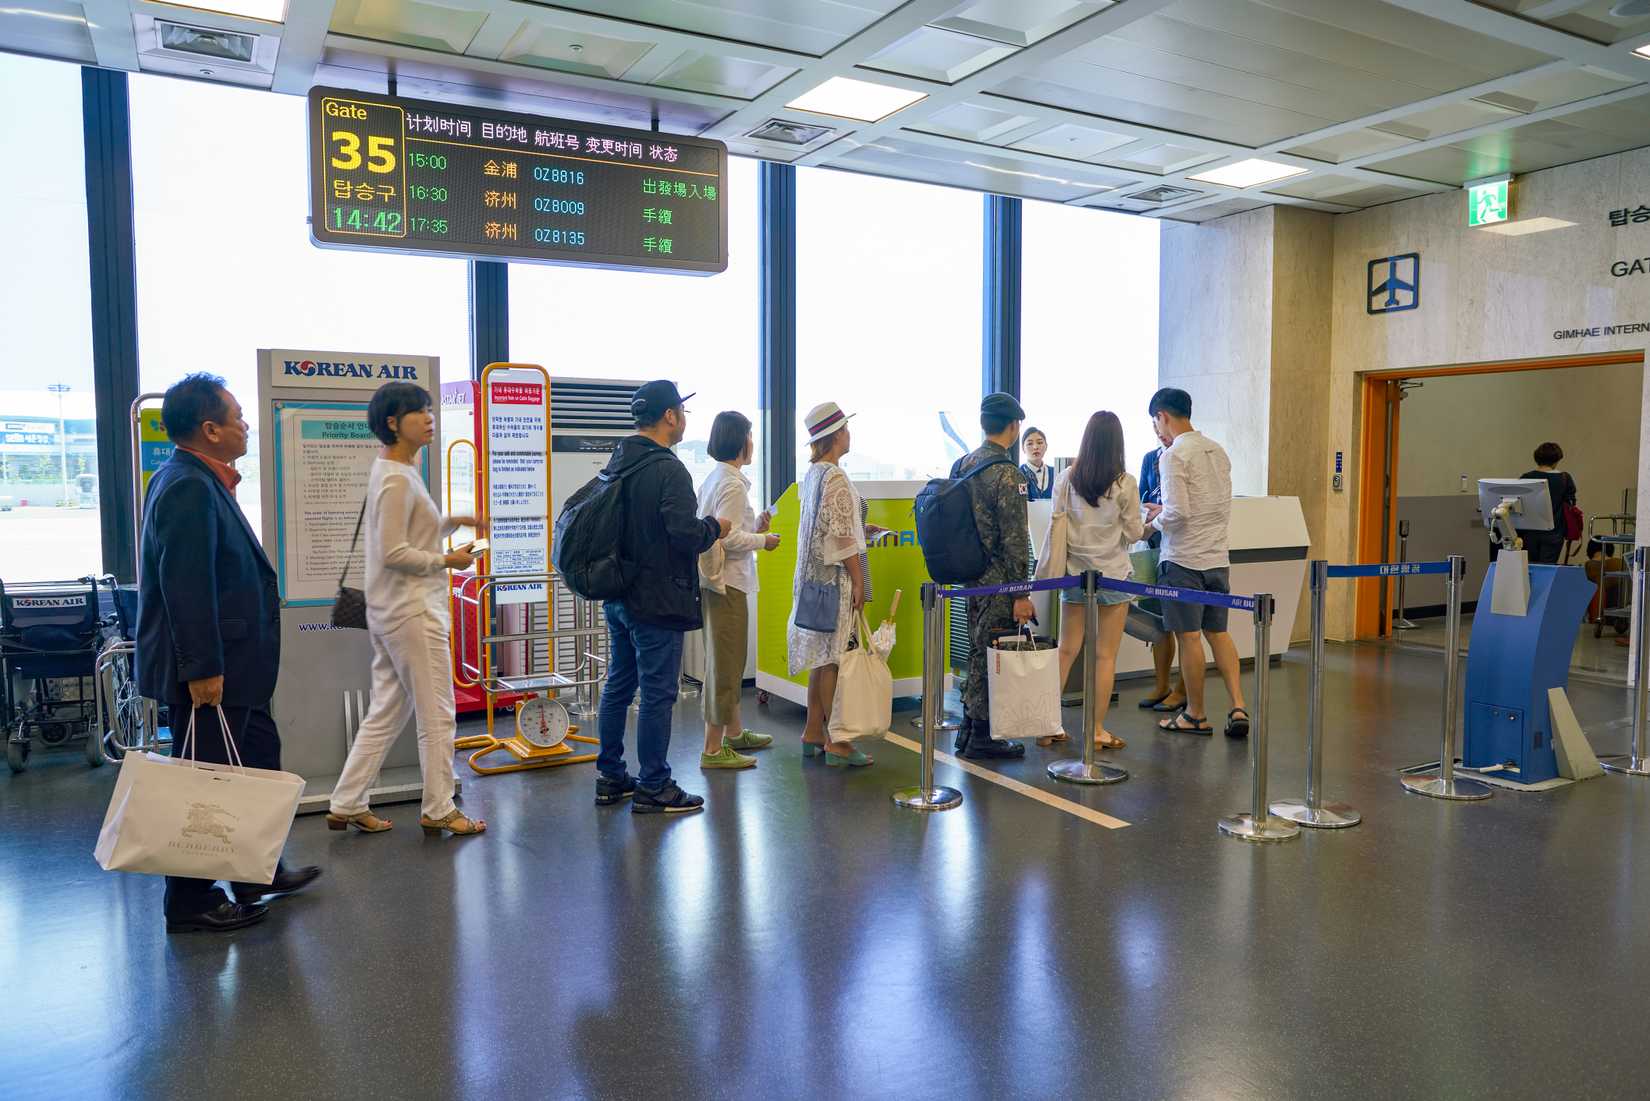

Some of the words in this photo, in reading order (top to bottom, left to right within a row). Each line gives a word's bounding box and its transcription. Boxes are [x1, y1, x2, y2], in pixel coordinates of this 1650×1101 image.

[325, 101, 368, 121] Gate
[406, 112, 472, 138] 计划时间
[482, 121, 528, 143] 目的地
[534, 129, 580, 151] 航班号
[585, 136, 643, 159] 变更时间
[649, 144, 679, 163] 状态
[331, 130, 397, 174] 35
[409, 153, 448, 170] 15:00
[483, 159, 518, 179] 金浦
[533, 166, 585, 185] OZ8816
[333, 179, 397, 203] 탑승구
[409, 185, 448, 202] 16:30
[484, 190, 517, 209] 济州
[534, 197, 585, 215] OZ8009
[333, 206, 401, 233] 14:42
[410, 217, 448, 234] 17:35
[484, 221, 517, 241] 济州
[534, 228, 585, 246] OZ8135
[1552, 326, 1601, 340] GIMHAE
[1603, 321, 1650, 336] INTERN
[283, 360, 374, 378] KOREAN
[376, 363, 419, 380] AIR
[322, 431, 350, 441] Priority
[16, 598, 60, 607] KOREAN
[62, 597, 84, 606] AIR
